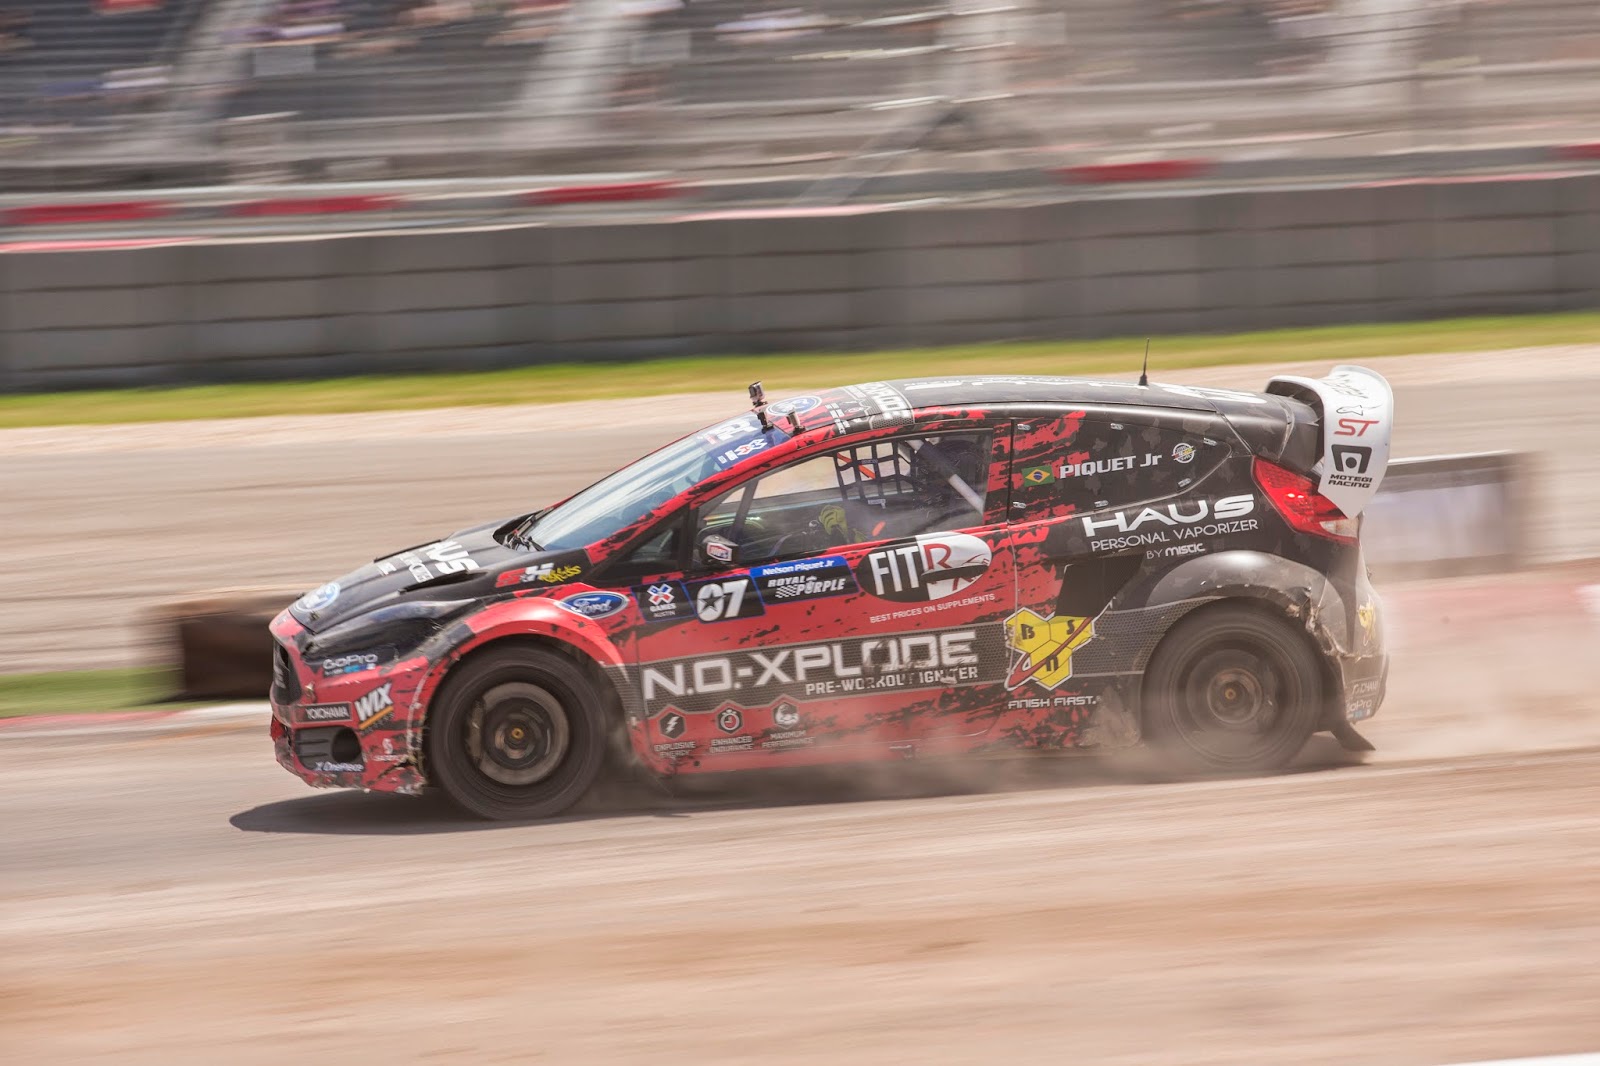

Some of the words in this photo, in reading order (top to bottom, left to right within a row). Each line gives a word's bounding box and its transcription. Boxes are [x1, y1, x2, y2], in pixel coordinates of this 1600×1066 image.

[1333, 418, 1380, 437] ST
[1060, 455, 1137, 479] PIQUET
[1140, 453, 1163, 468] Jr
[1328, 480, 1371, 489] RACING
[1330, 473, 1373, 483] MOTEGI
[1082, 494, 1255, 537] HAUS
[1091, 531, 1171, 552] PERSONAL
[1173, 519, 1259, 540] VAPORIZER
[1146, 550, 1162, 560] BY
[762, 564, 794, 576] Nelson
[795, 560, 824, 573] Piquet
[824, 558, 836, 568] Jr
[768, 576, 806, 588] ROYAL
[796, 577, 846, 596] PURPLE
[571, 597, 613, 613] Ford
[650, 603, 677, 612] GAMES
[696, 578, 750, 622] 07
[870, 613, 891, 624] BEST
[892, 607, 923, 620] PRICES
[923, 604, 937, 613] ON
[937, 593, 996, 612] SUPPLEMENTS
[322, 653, 379, 670] GoPro
[918, 666, 979, 684] IGNTER
[354, 682, 394, 721] WIX
[1007, 697, 1051, 710] FINISH
[305, 705, 350, 719] YOKOHAMA
